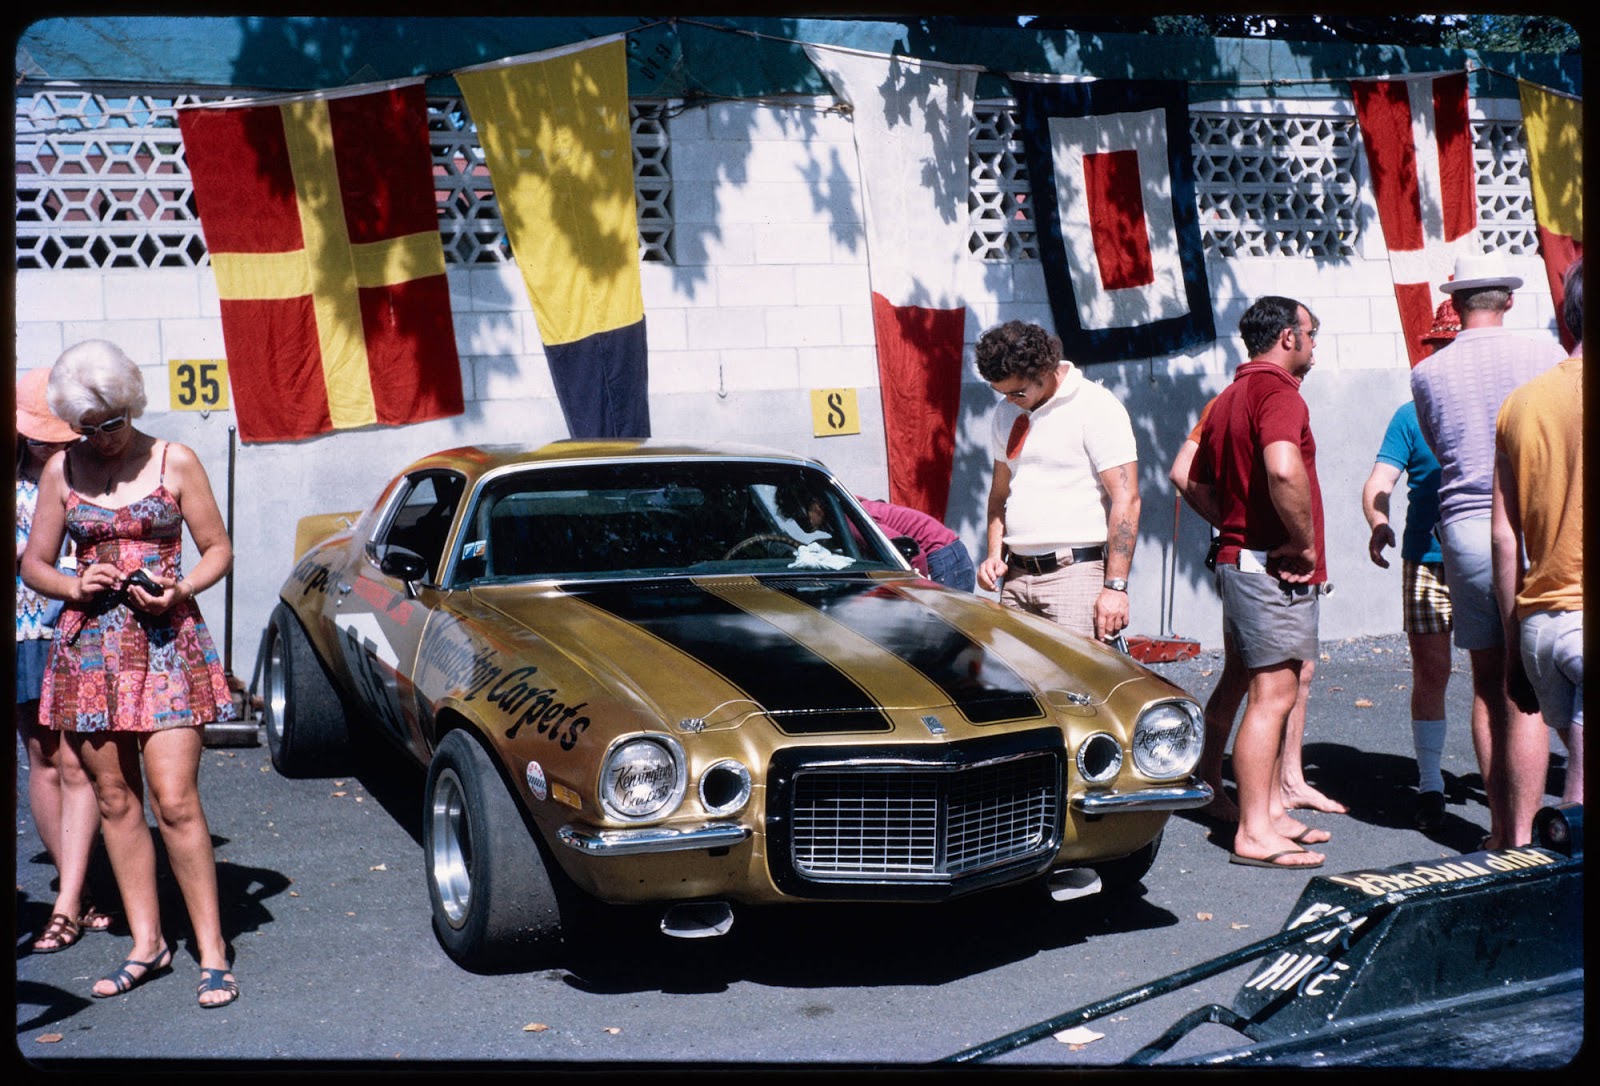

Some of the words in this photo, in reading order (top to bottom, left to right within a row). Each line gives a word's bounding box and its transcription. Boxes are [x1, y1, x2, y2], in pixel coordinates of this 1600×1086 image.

[177, 364, 220, 405] 35
[487, 666, 590, 751] Carpets
[612, 763, 673, 793] Kensington
[1245, 952, 1350, 996] HIRE
